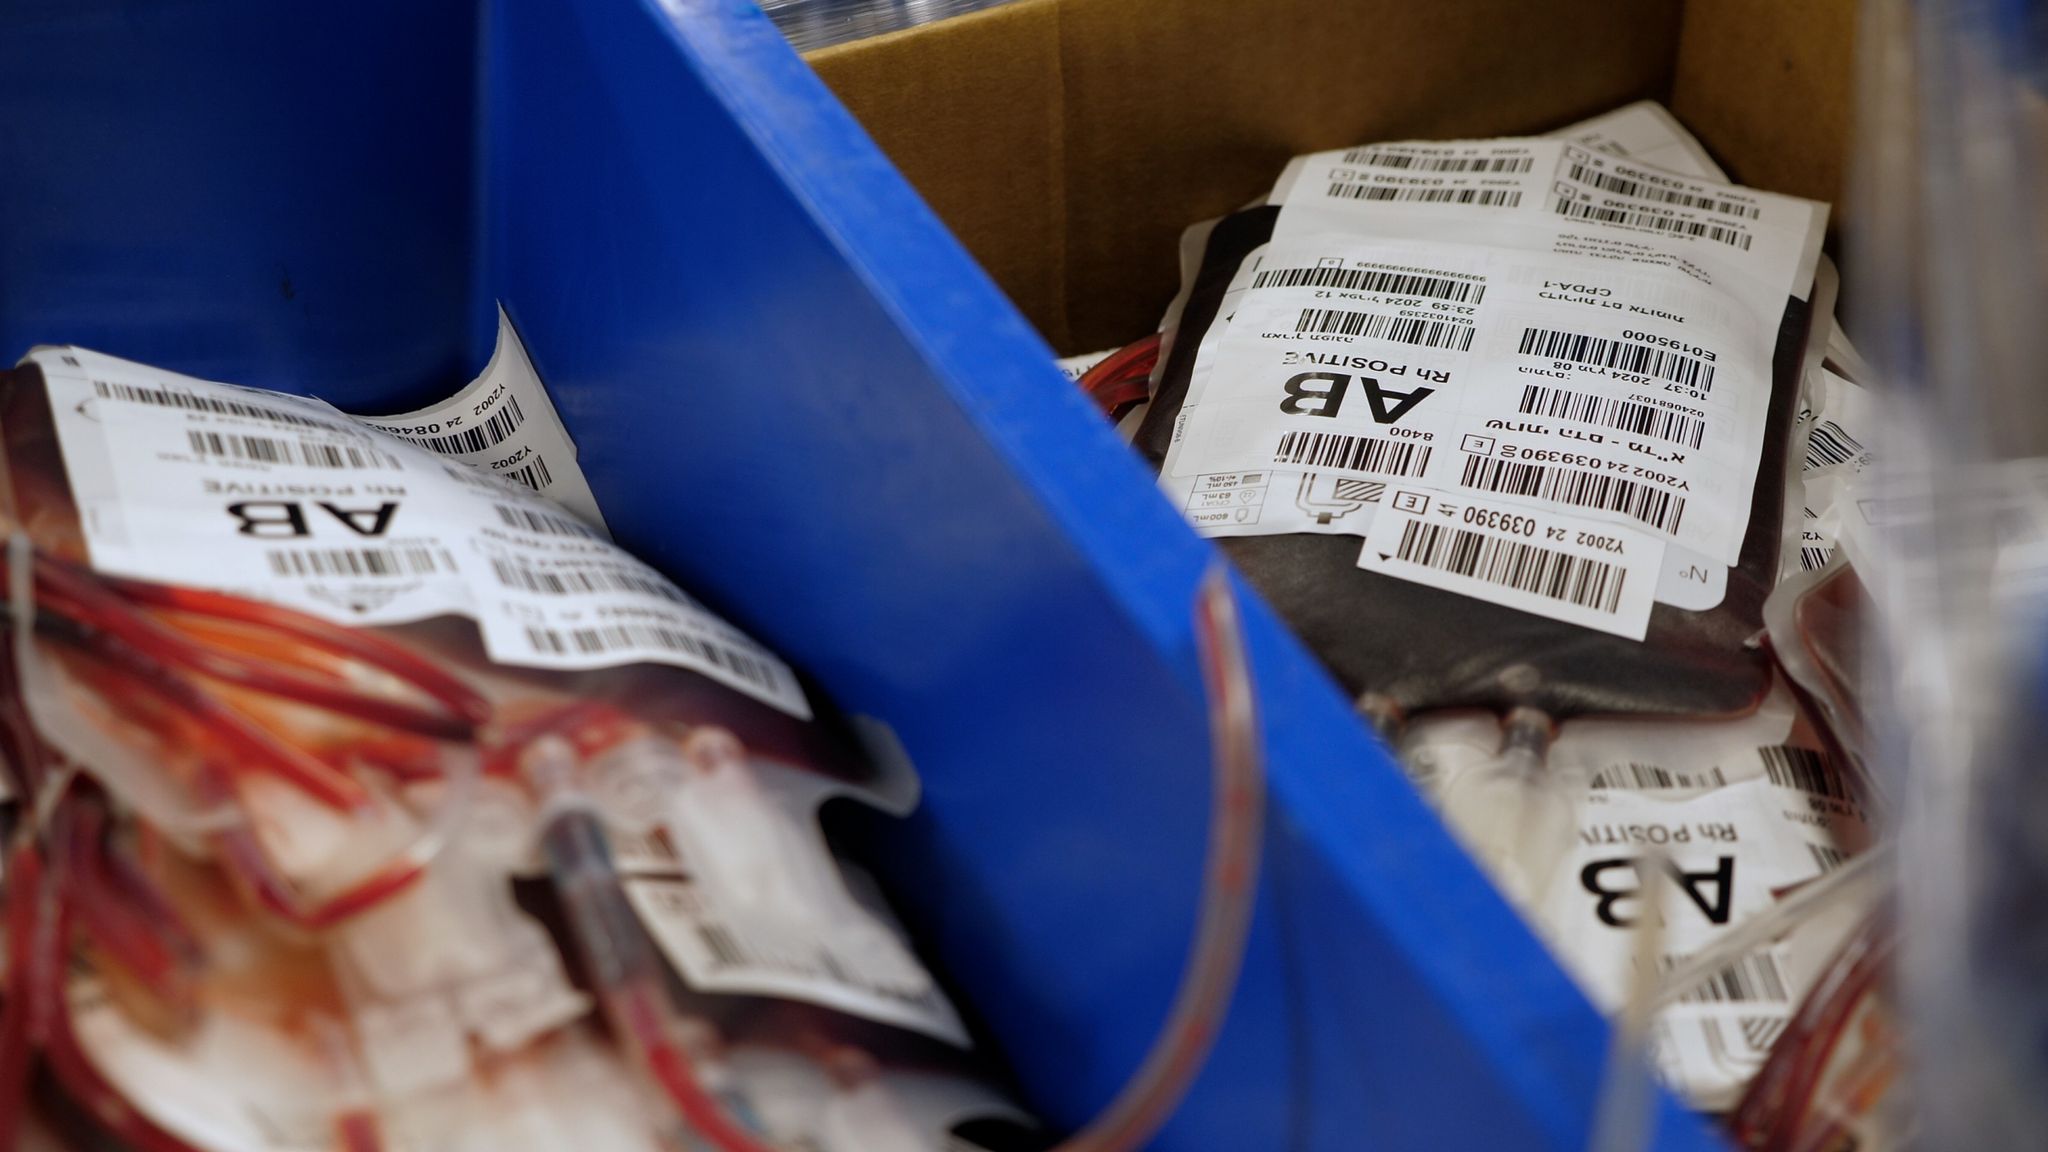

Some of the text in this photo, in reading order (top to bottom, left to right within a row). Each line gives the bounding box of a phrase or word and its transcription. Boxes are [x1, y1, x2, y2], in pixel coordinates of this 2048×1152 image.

[1544, 280, 1612, 297] CPDA-1
[1314, 290, 1475, 315] 12 אפריל 2024 23:59
[1538, 291, 1686, 323] כדוריות דם אדומות
[1399, 309, 1473, 325] 0241032359
[1309, 332, 1354, 343] תפוגה
[1622, 329, 1717, 362] E0195000
[1282, 351, 1450, 383] Rh POSITIVE
[1553, 361, 1708, 401] 08 מרץ 2024 10:37
[473, 383, 506, 416] Y2002
[1279, 371, 1435, 424] AB
[1628, 393, 1705, 418] 0240681037
[446, 416, 463, 428] 24
[1389, 427, 1434, 441] 8400
[1485, 419, 1549, 435] שרותי
[1559, 428, 1603, 443] הדם
[1473, 440, 1484, 449] E
[490, 445, 533, 469] Y2002
[1521, 448, 1602, 469] 039390
[1607, 461, 1628, 473] 24
[1633, 466, 1690, 492] Y2002
[1406, 496, 1418, 508] E
[226, 502, 400, 538] AB
[1463, 506, 1536, 537] 039390
[1546, 526, 1567, 541] 24
[1576, 531, 1624, 554] Y2002
[1698, 822, 1738, 842] Rh
[1580, 856, 1735, 927] AB
